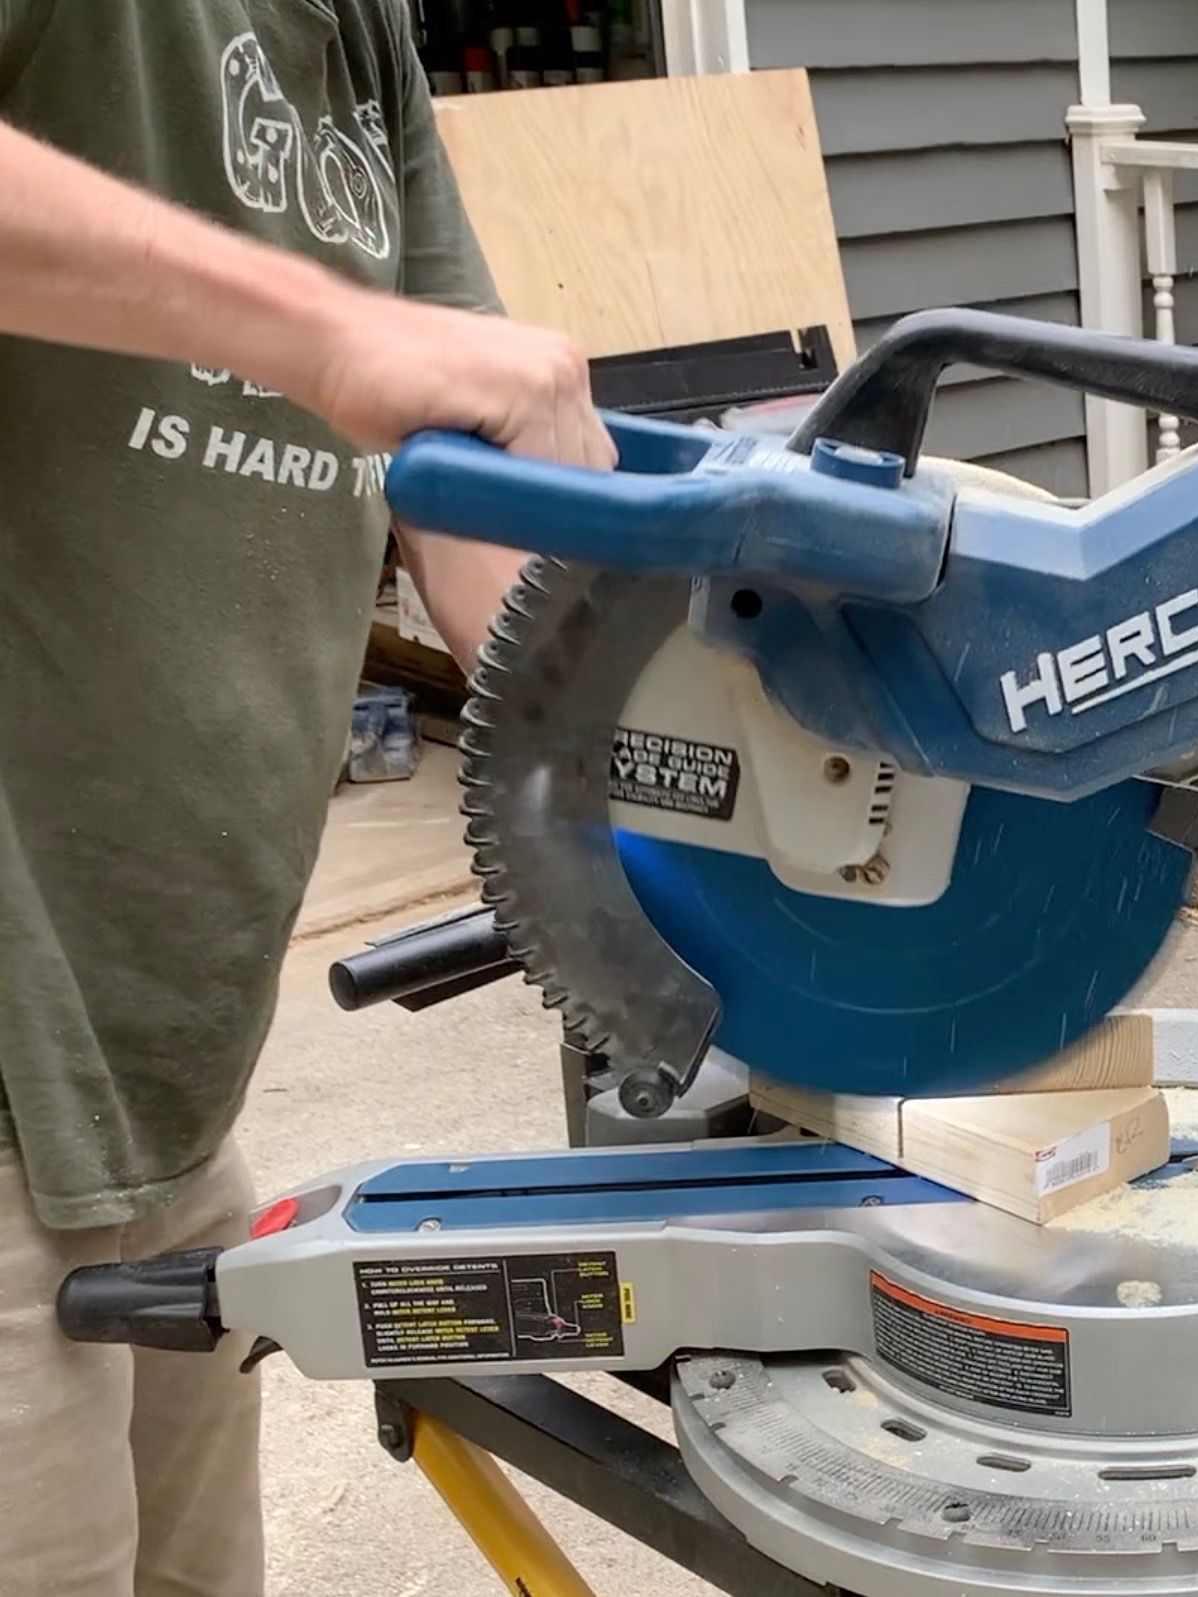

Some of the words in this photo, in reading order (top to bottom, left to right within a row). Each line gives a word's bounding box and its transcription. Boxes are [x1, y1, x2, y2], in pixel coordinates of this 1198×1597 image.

[127, 406, 190, 460] IS
[202, 425, 339, 492] HARD
[614, 757, 727, 799] YSTEM
[667, 755, 730, 780] GUIDE
